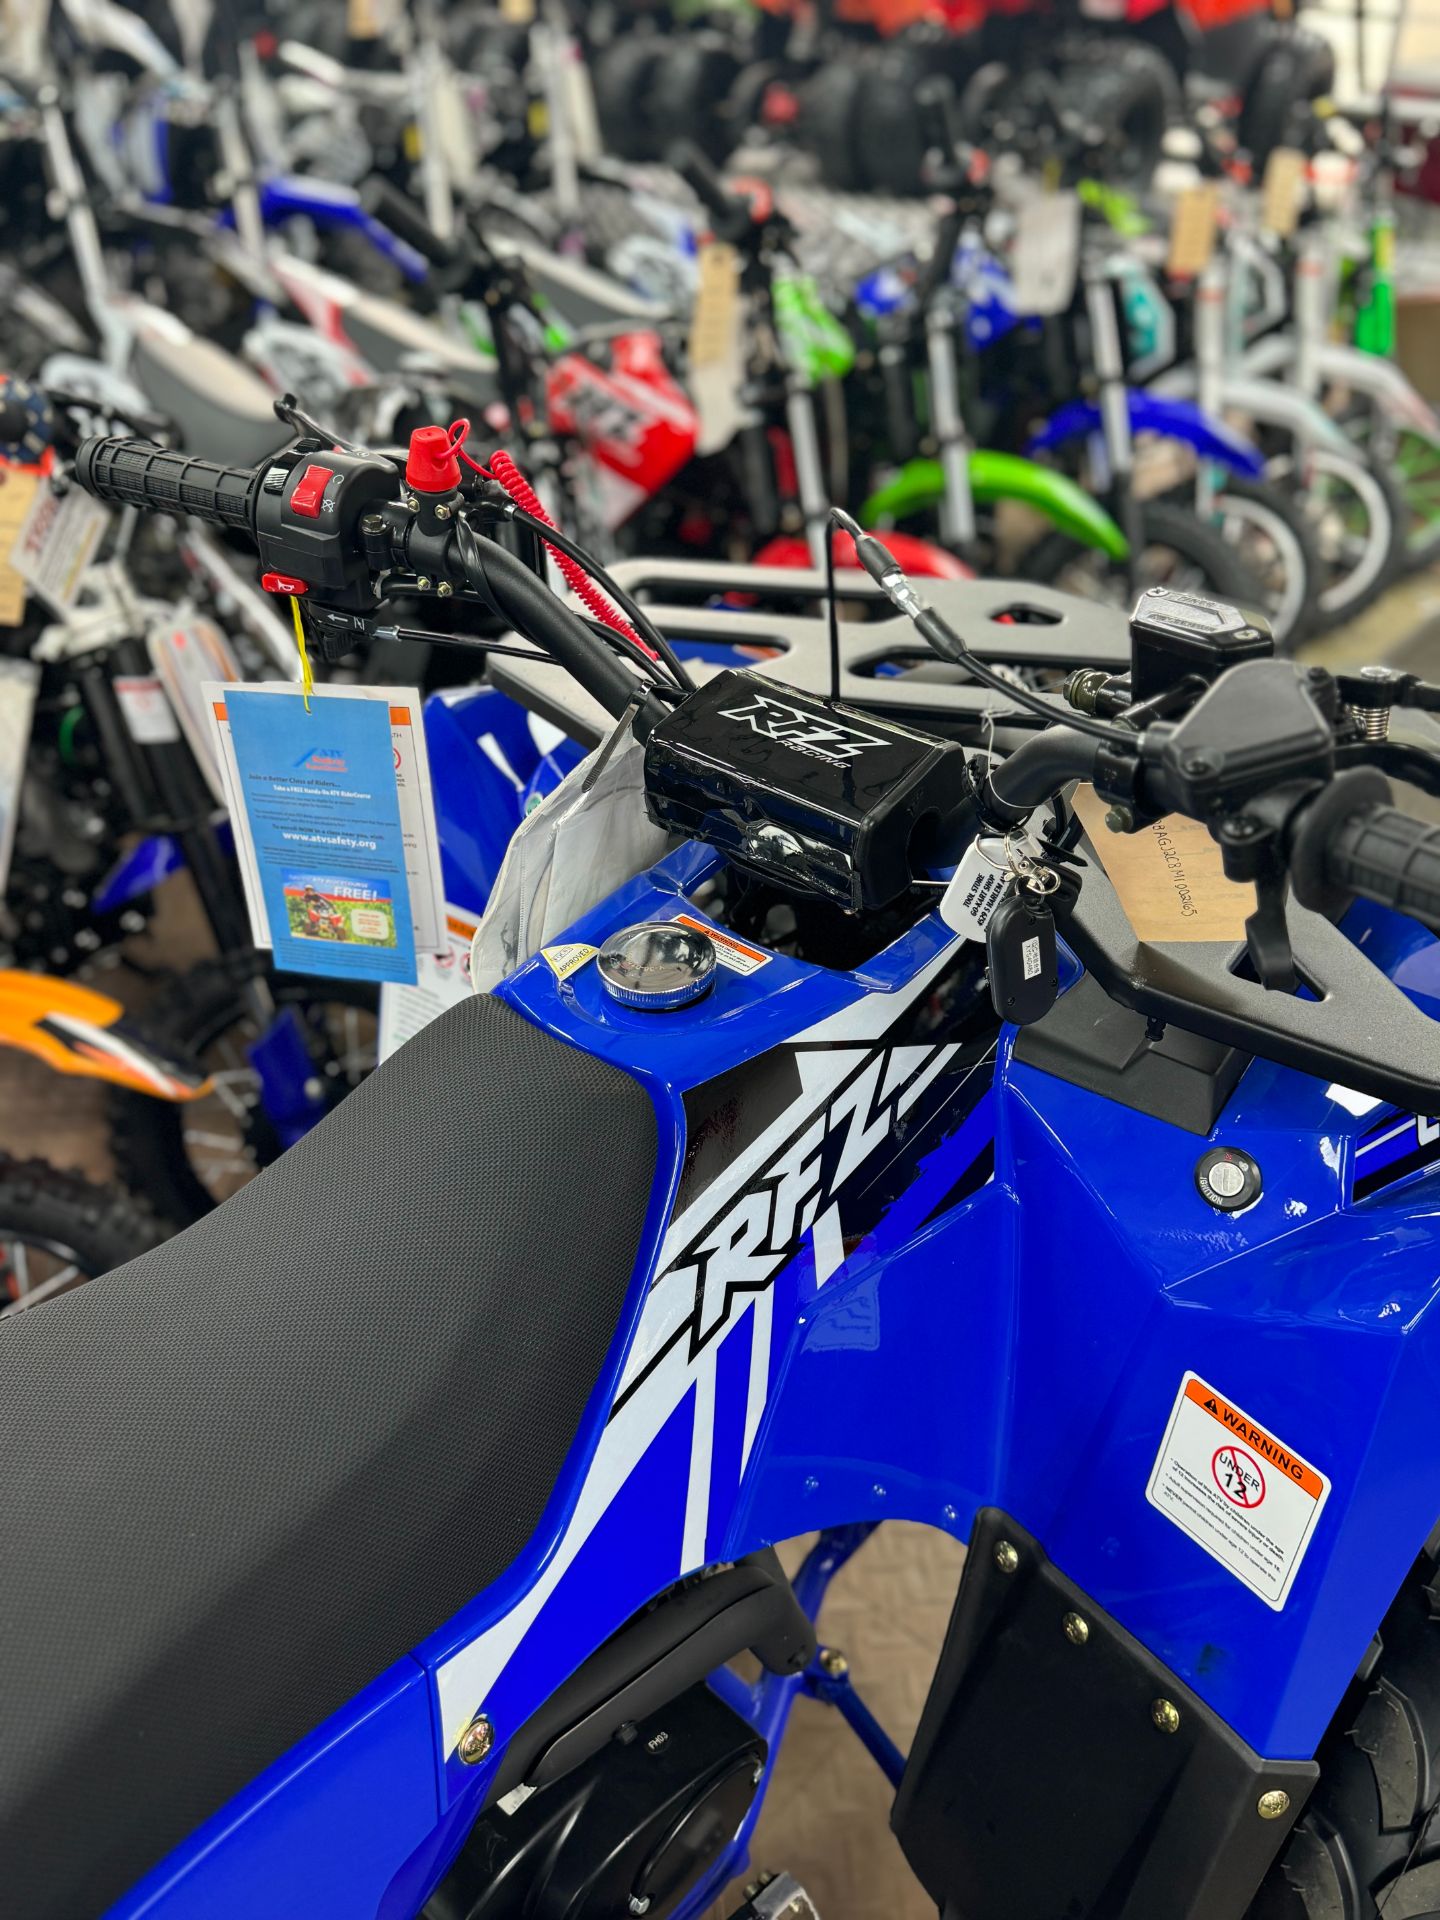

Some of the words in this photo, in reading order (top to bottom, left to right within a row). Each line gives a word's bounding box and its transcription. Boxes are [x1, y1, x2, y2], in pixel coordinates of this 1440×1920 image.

[775, 740, 852, 769] RACING
[282, 831, 377, 850] www.atvsafety.org
[334, 886, 377, 902] FREE!
[963, 892, 976, 908] TOOL
[971, 872, 985, 894] STORE
[970, 889, 988, 917] GO-KART
[983, 873, 996, 892] SHOP
[977, 911, 988, 926] 4529
[985, 882, 1003, 909] HARLEM
[559, 948, 590, 973] APPROVED
[1199, 1176, 1224, 1206] IGNITION
[1223, 1408, 1304, 1480] WARNING
[1219, 1452, 1260, 1493] UNDER
[1225, 1472, 1247, 1500] 12
[1165, 1485, 1182, 1502] NEVER
[1196, 1511, 1214, 1529] children
[1214, 1527, 1228, 1541] under
[1227, 1538, 1237, 1549] age
[1173, 1459, 1197, 1482] Operation
[1197, 1479, 1203, 1487] of
[1212, 1492, 1223, 1503] ATV
[1222, 1500, 1229, 1509] by
[1229, 1506, 1250, 1526] children
[1249, 1523, 1265, 1539] under
[1265, 1536, 1274, 1546] the
[1273, 1543, 1284, 1555] age
[1206, 1494, 1215, 1504] the
[1215, 1501, 1224, 1512] risk
[1225, 1509, 1231, 1517] of
[1247, 1528, 1262, 1543] injury
[1262, 1540, 1268, 1549] or
[1230, 1527, 1250, 1546] children
[1249, 1543, 1263, 1557] under
[1263, 1555, 1273, 1566] age
